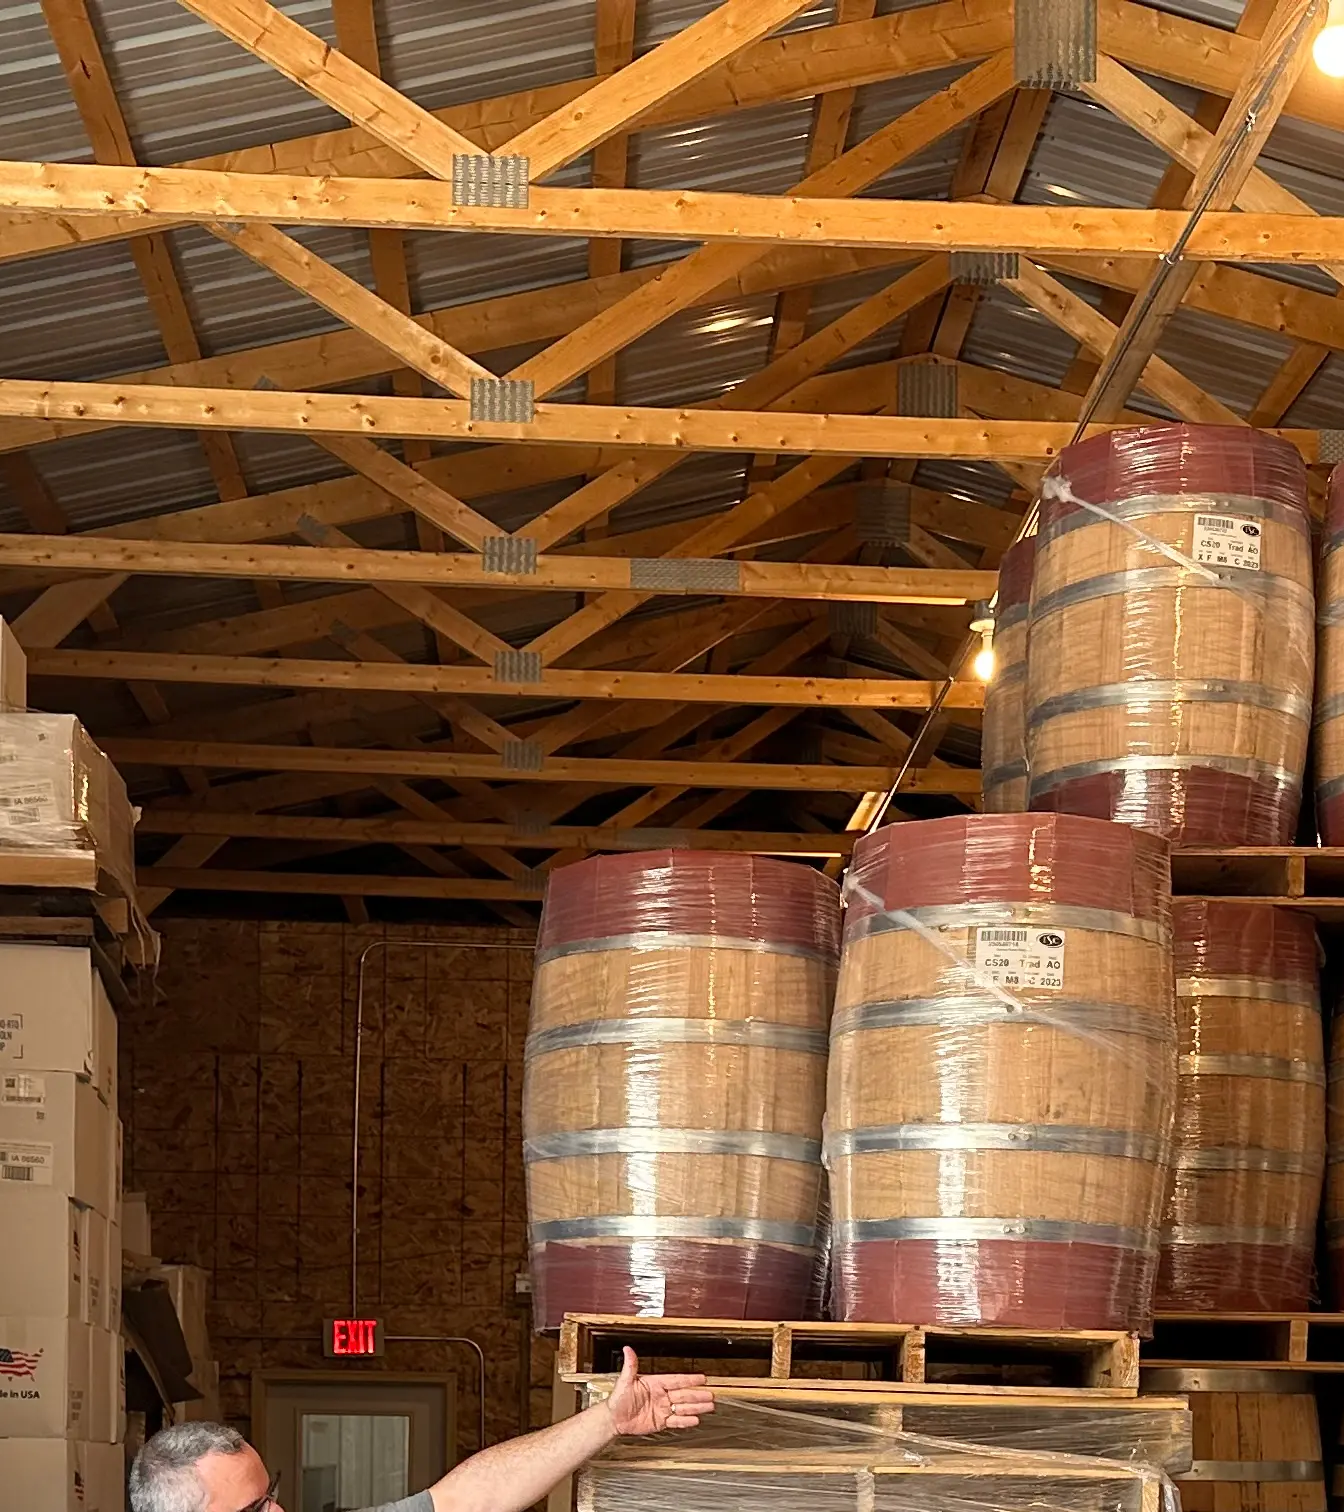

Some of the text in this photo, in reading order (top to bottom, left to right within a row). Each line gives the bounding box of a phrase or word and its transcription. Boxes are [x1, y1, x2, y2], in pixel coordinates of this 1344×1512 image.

[1228, 543, 1244, 552] Trad
[984, 958, 1010, 968] CS20
[333, 1320, 377, 1354] EXIT
[10, 1389, 19, 1398] in
[20, 1390, 40, 1399] USA
